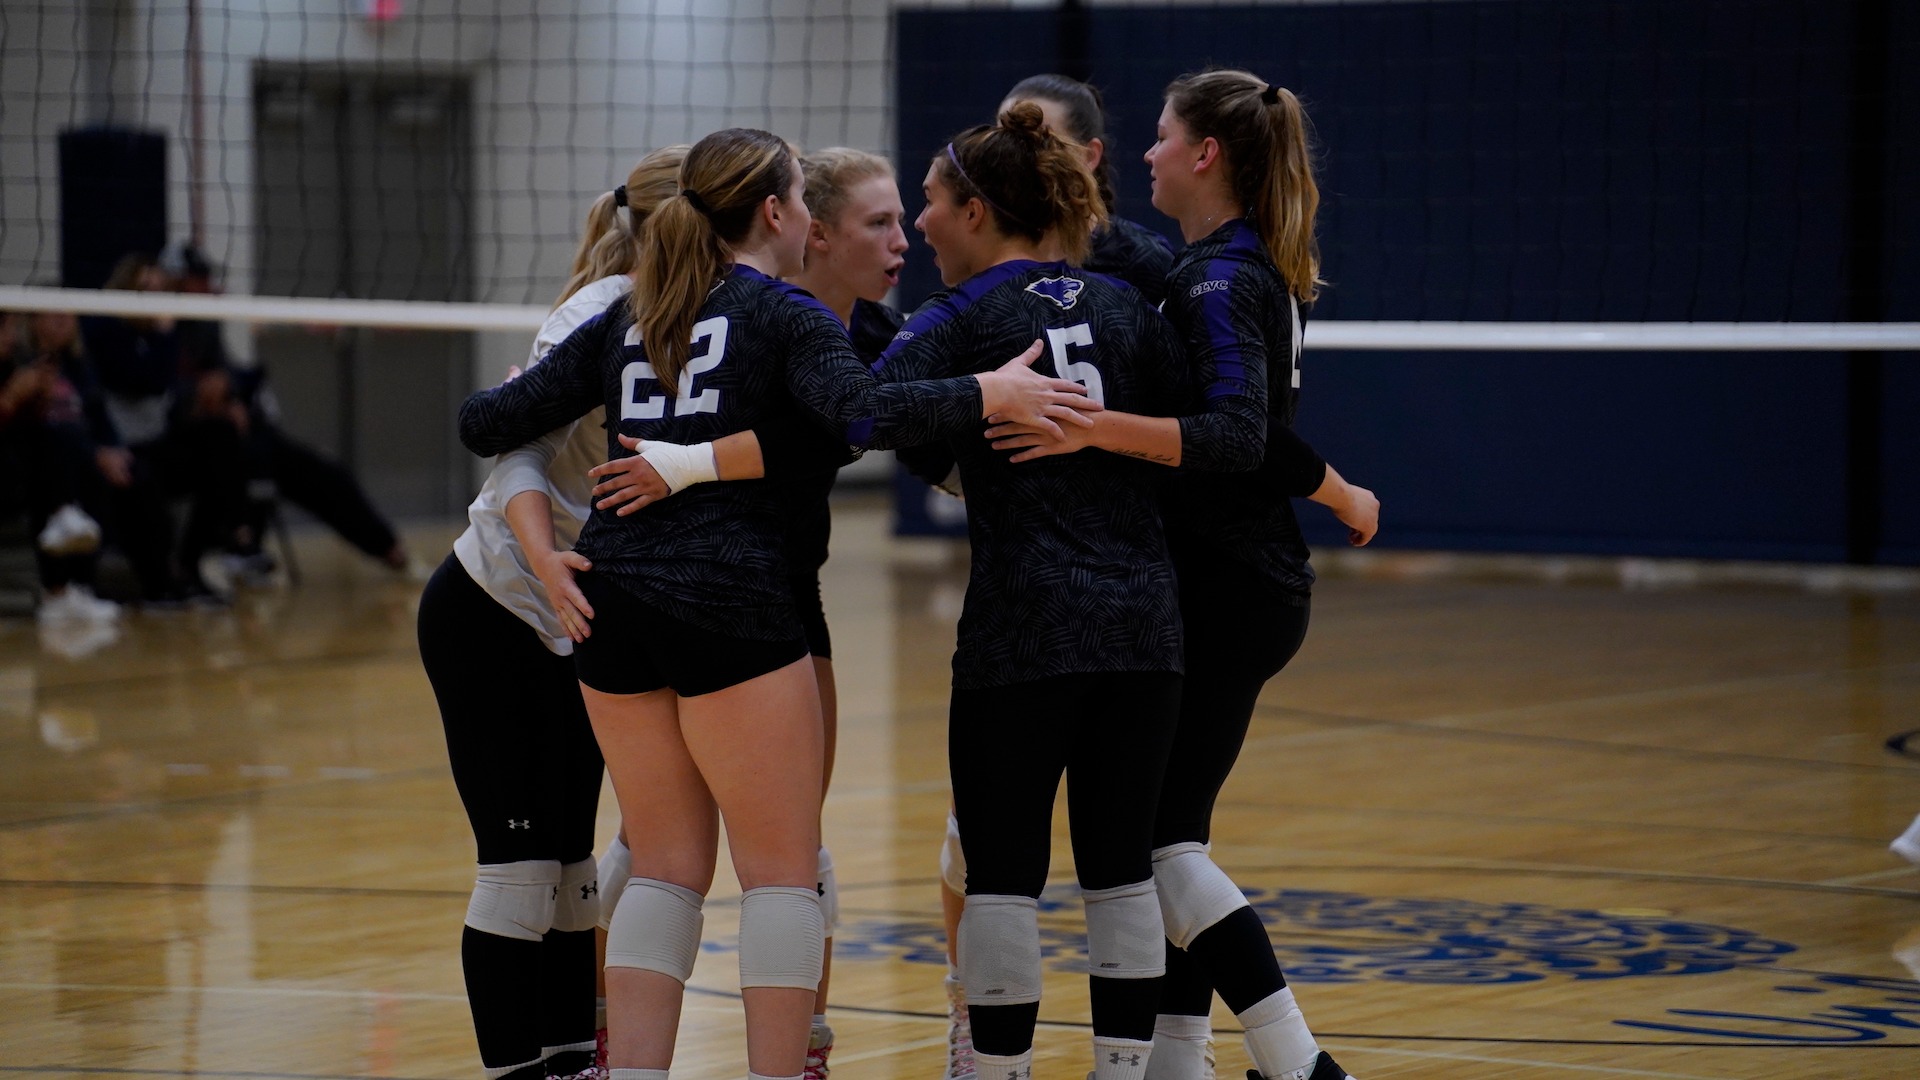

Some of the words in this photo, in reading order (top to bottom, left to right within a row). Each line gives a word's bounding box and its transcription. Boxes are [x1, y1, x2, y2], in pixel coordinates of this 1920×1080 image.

[1190, 280, 1229, 298] GLVC
[620, 316, 729, 421] 22
[1046, 322, 1105, 411] 5
